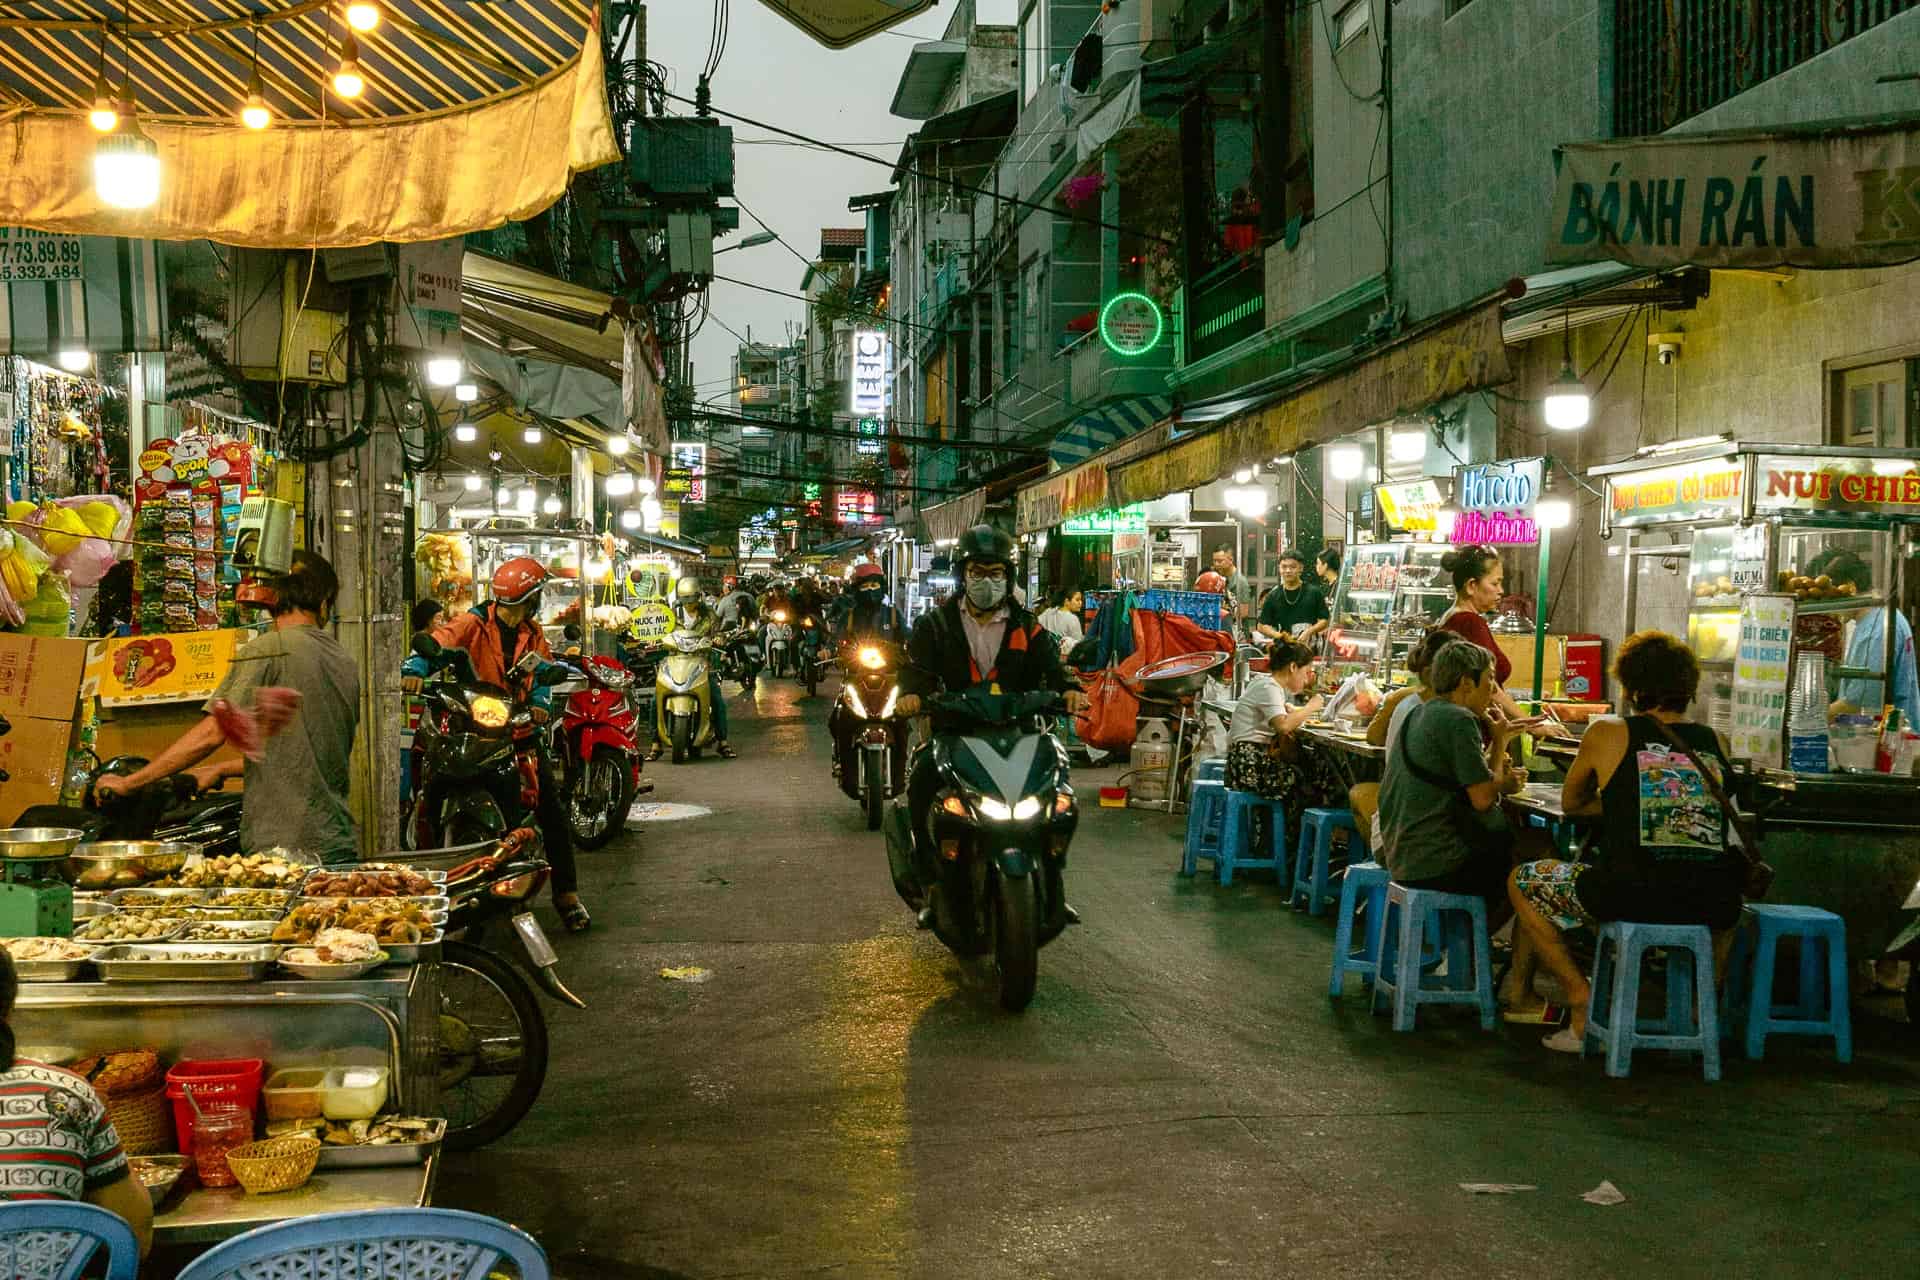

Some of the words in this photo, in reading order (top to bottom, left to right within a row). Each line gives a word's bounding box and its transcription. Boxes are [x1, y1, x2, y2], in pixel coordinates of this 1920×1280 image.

[1561, 161, 1686, 246] BÁNH
[1700, 155, 1816, 247] RÁN
[0, 264, 81, 280] 5.332.484
[1463, 464, 1489, 507] Há
